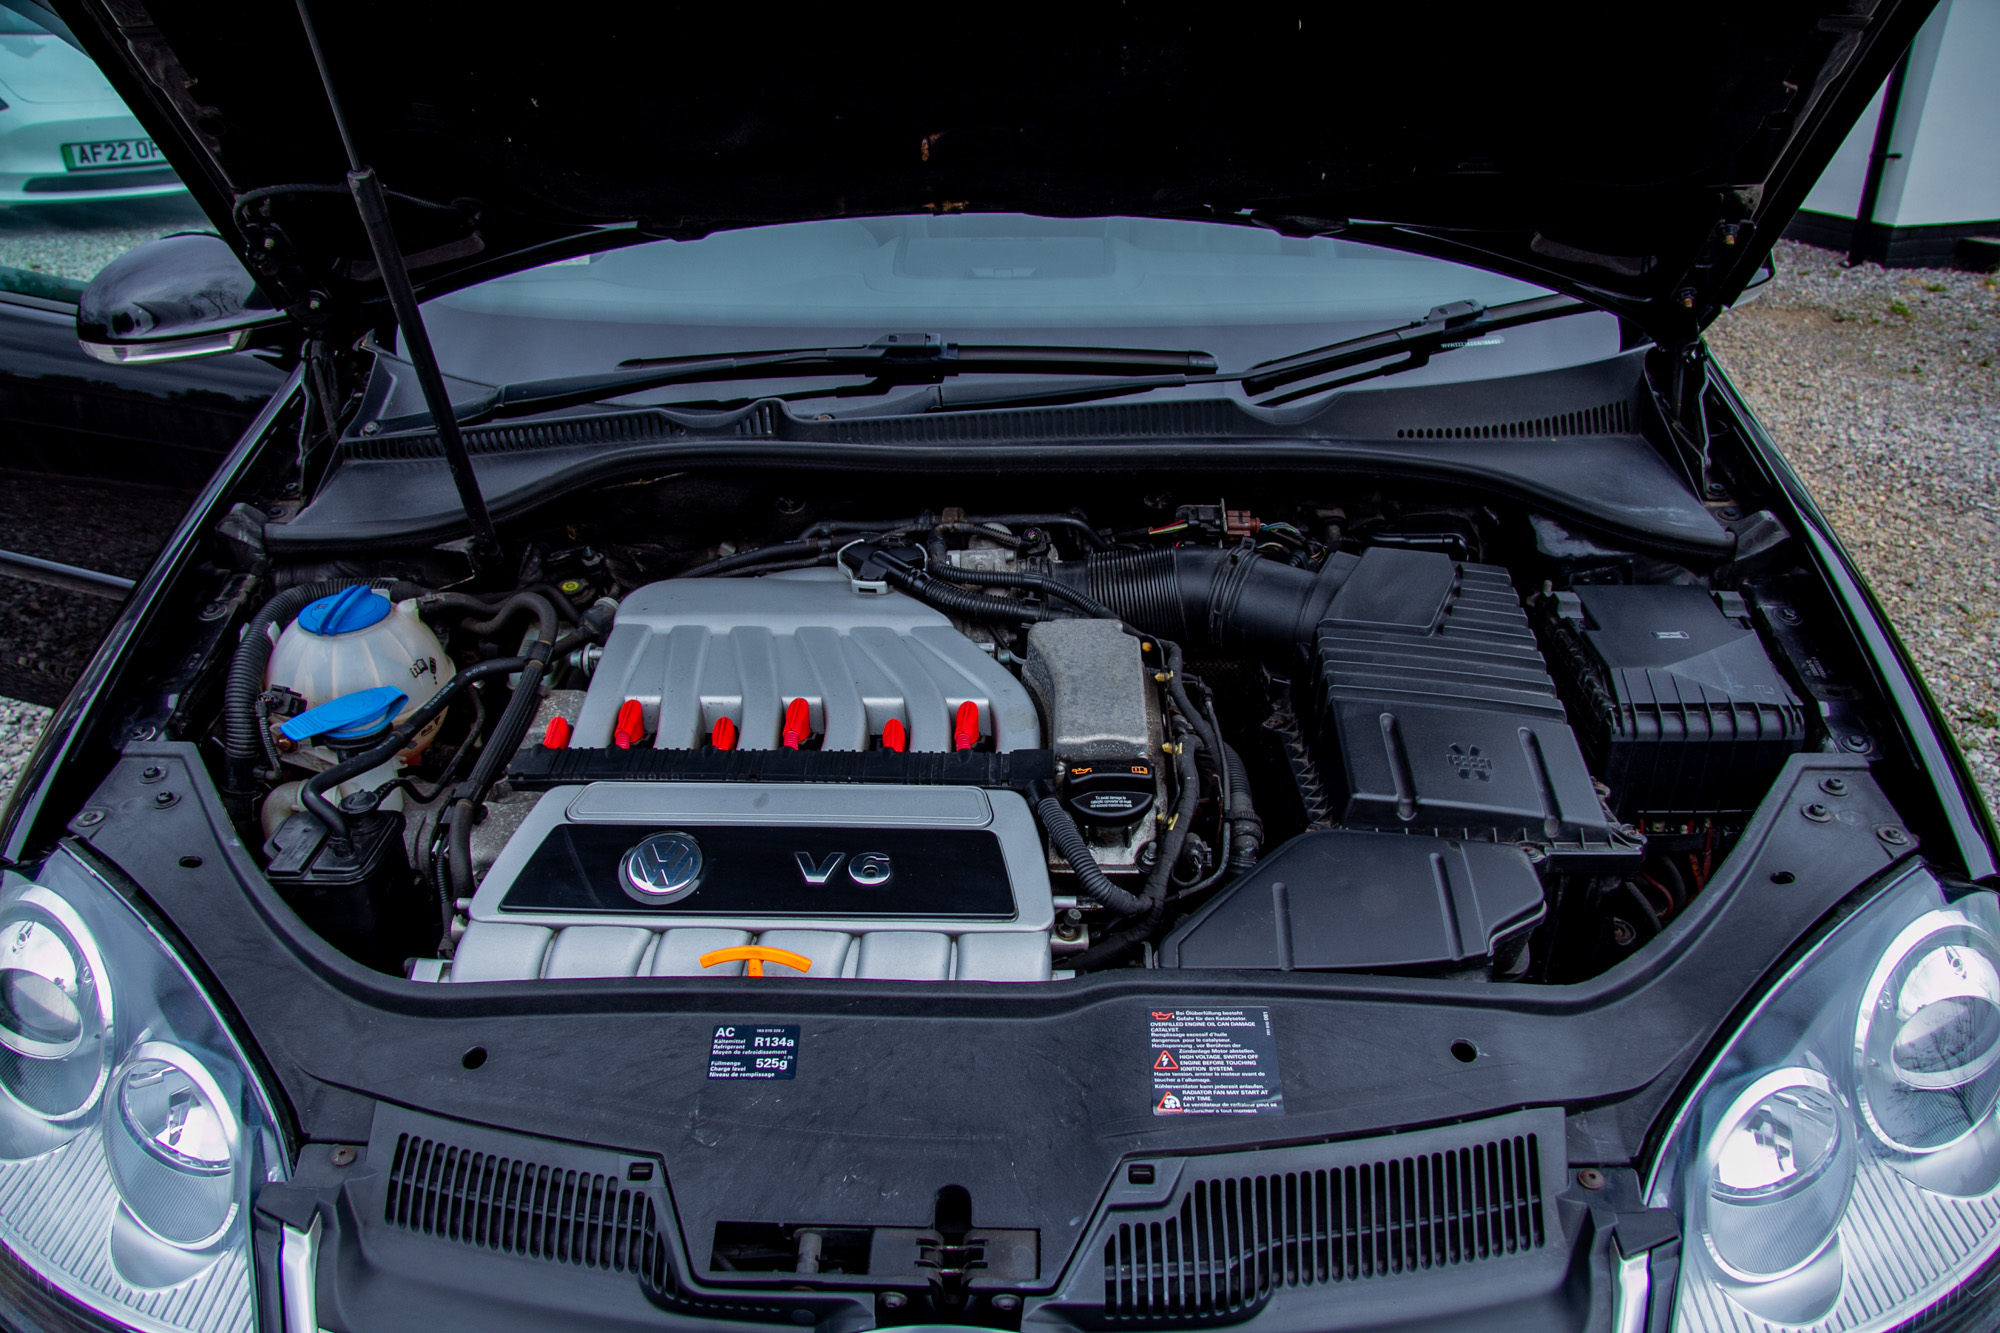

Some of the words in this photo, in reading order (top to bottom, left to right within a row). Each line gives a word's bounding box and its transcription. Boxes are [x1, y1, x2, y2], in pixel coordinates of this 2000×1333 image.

[79, 143, 132, 164] AF22
[794, 851, 891, 886] V6
[715, 1027, 735, 1038] AC
[754, 1037, 794, 1047] R134a
[756, 1058, 788, 1070] 525g
